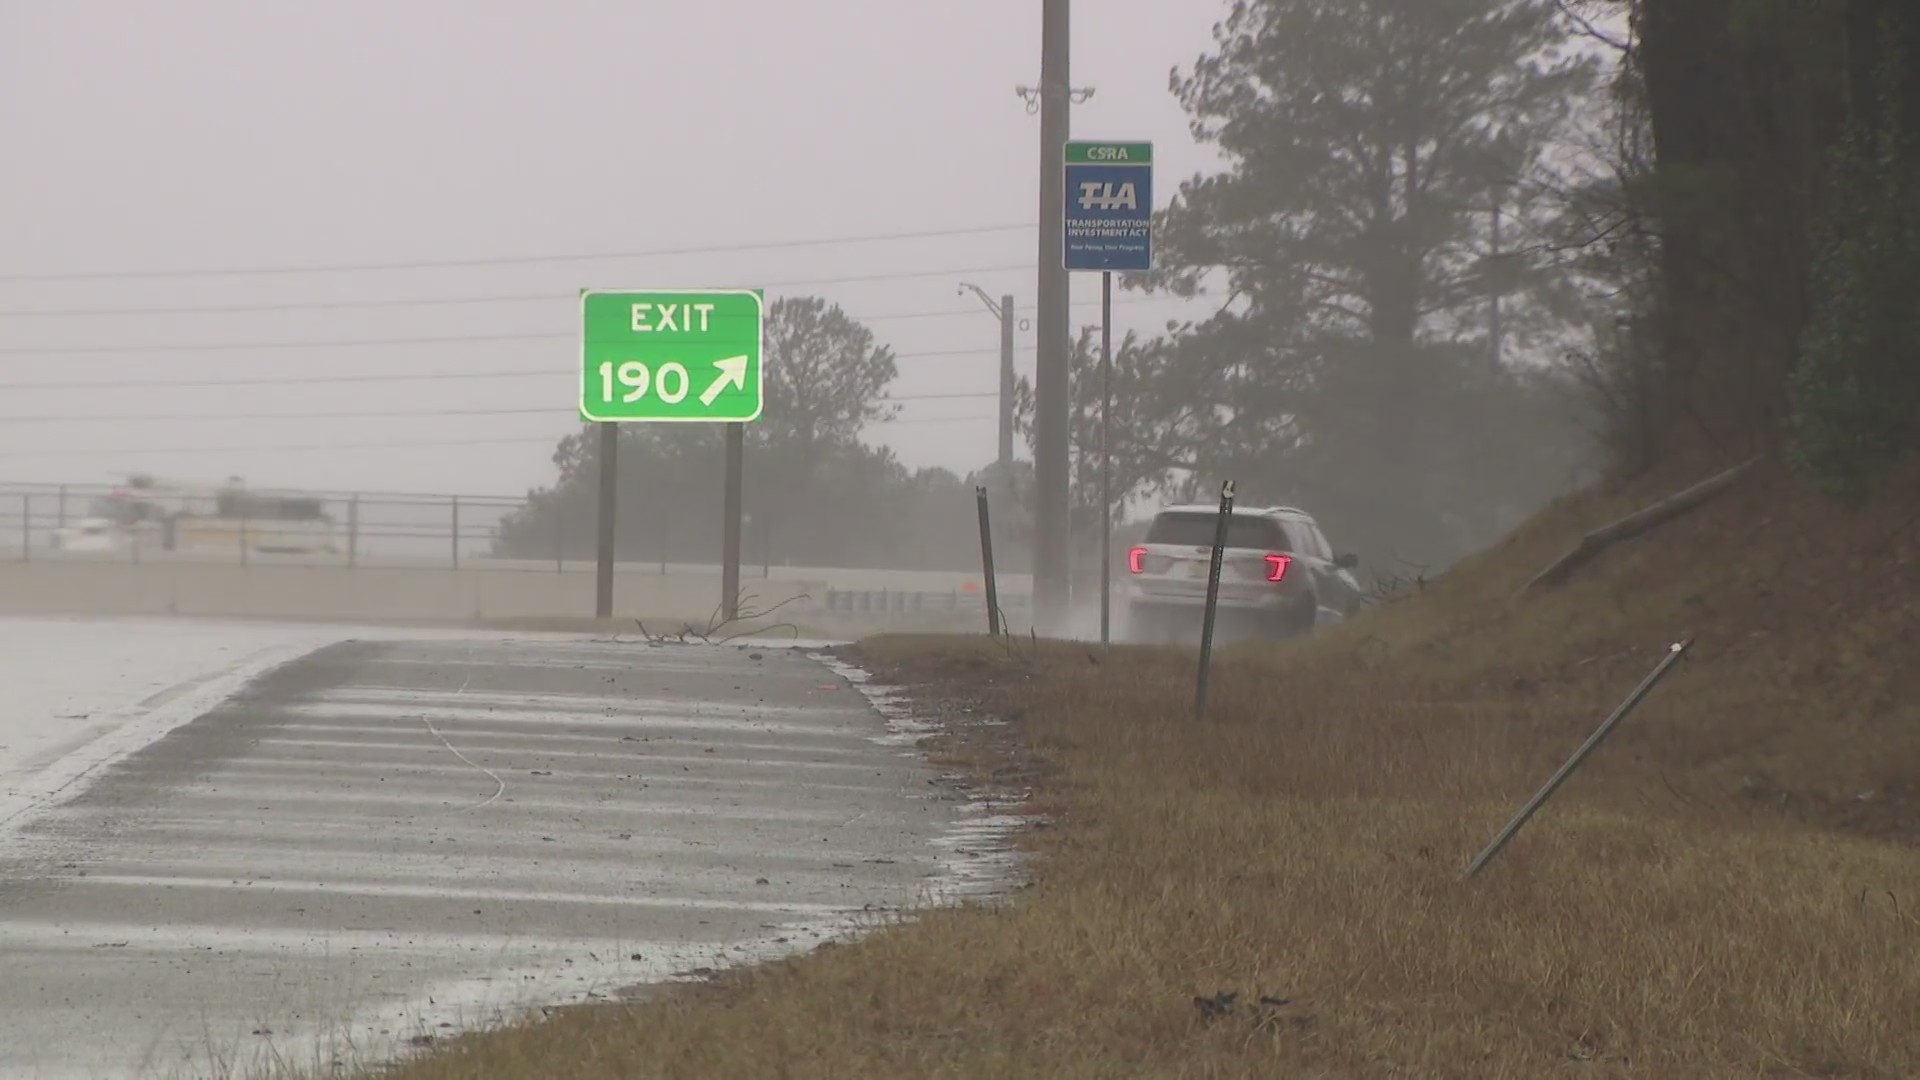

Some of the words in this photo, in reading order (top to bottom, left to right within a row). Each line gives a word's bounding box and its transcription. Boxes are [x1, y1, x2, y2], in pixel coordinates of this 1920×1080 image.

[1087, 147, 1128, 160] CSRA
[1078, 182, 1137, 210] TIA
[1066, 219, 1150, 228] TRANSPORTATION
[1068, 228, 1127, 237] INVESTMENT
[1129, 228, 1148, 237] ACT
[631, 303, 714, 332] EXIT
[599, 360, 690, 404] 190
